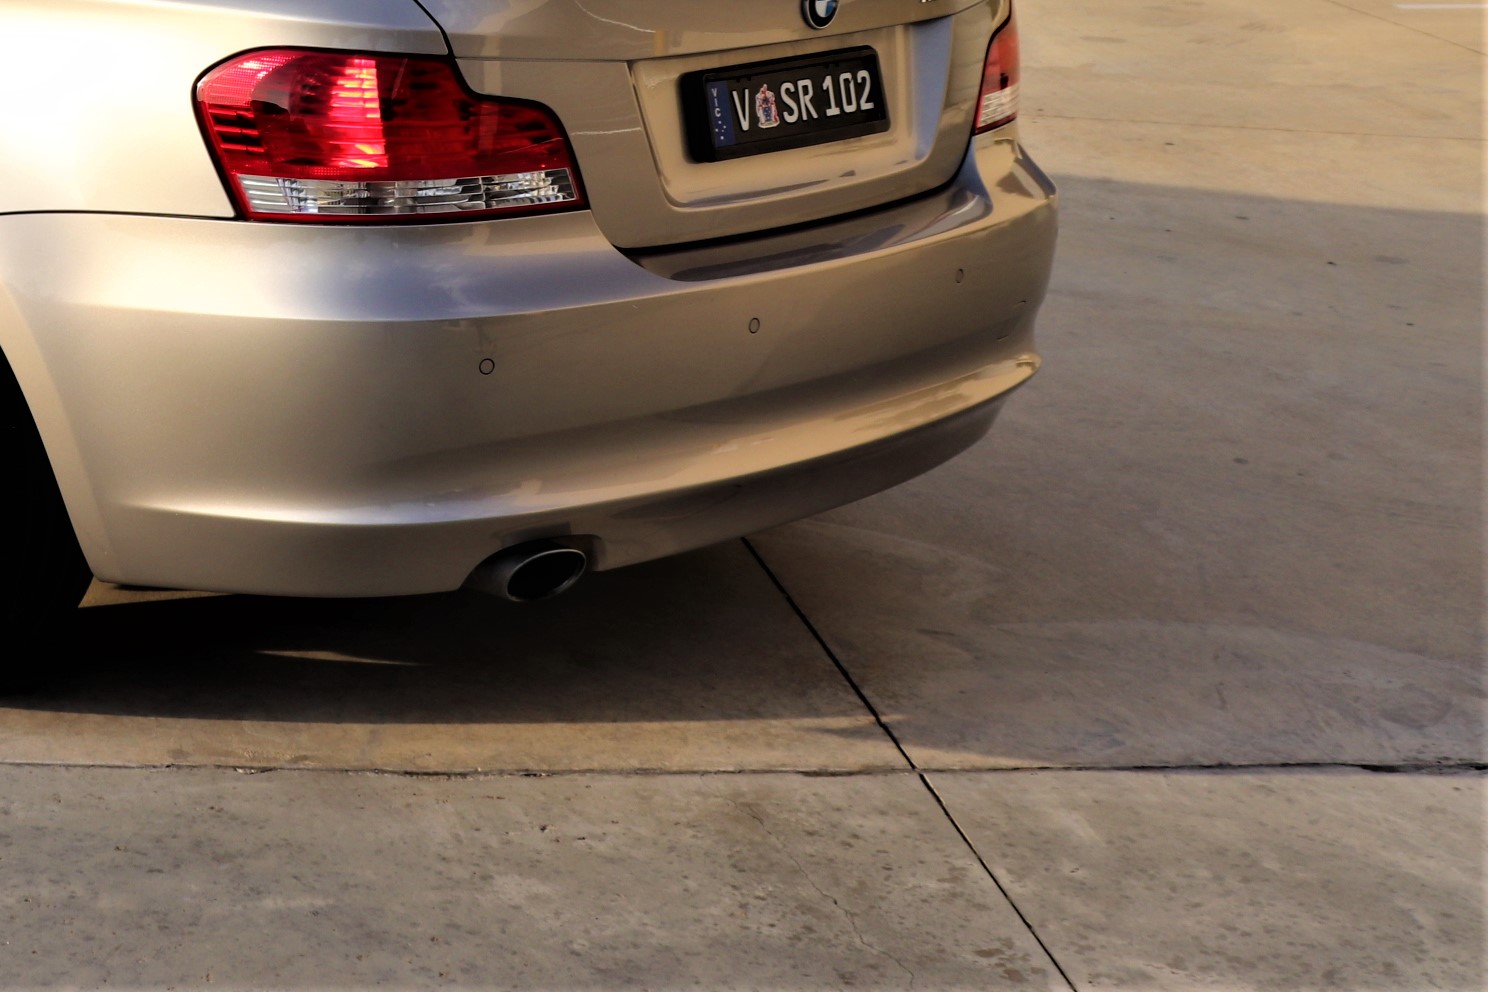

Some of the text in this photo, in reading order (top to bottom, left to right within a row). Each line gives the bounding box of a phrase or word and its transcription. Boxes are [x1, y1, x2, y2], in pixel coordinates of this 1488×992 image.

[711, 87, 722, 117] VIC
[732, 70, 874, 131] V SR 102
